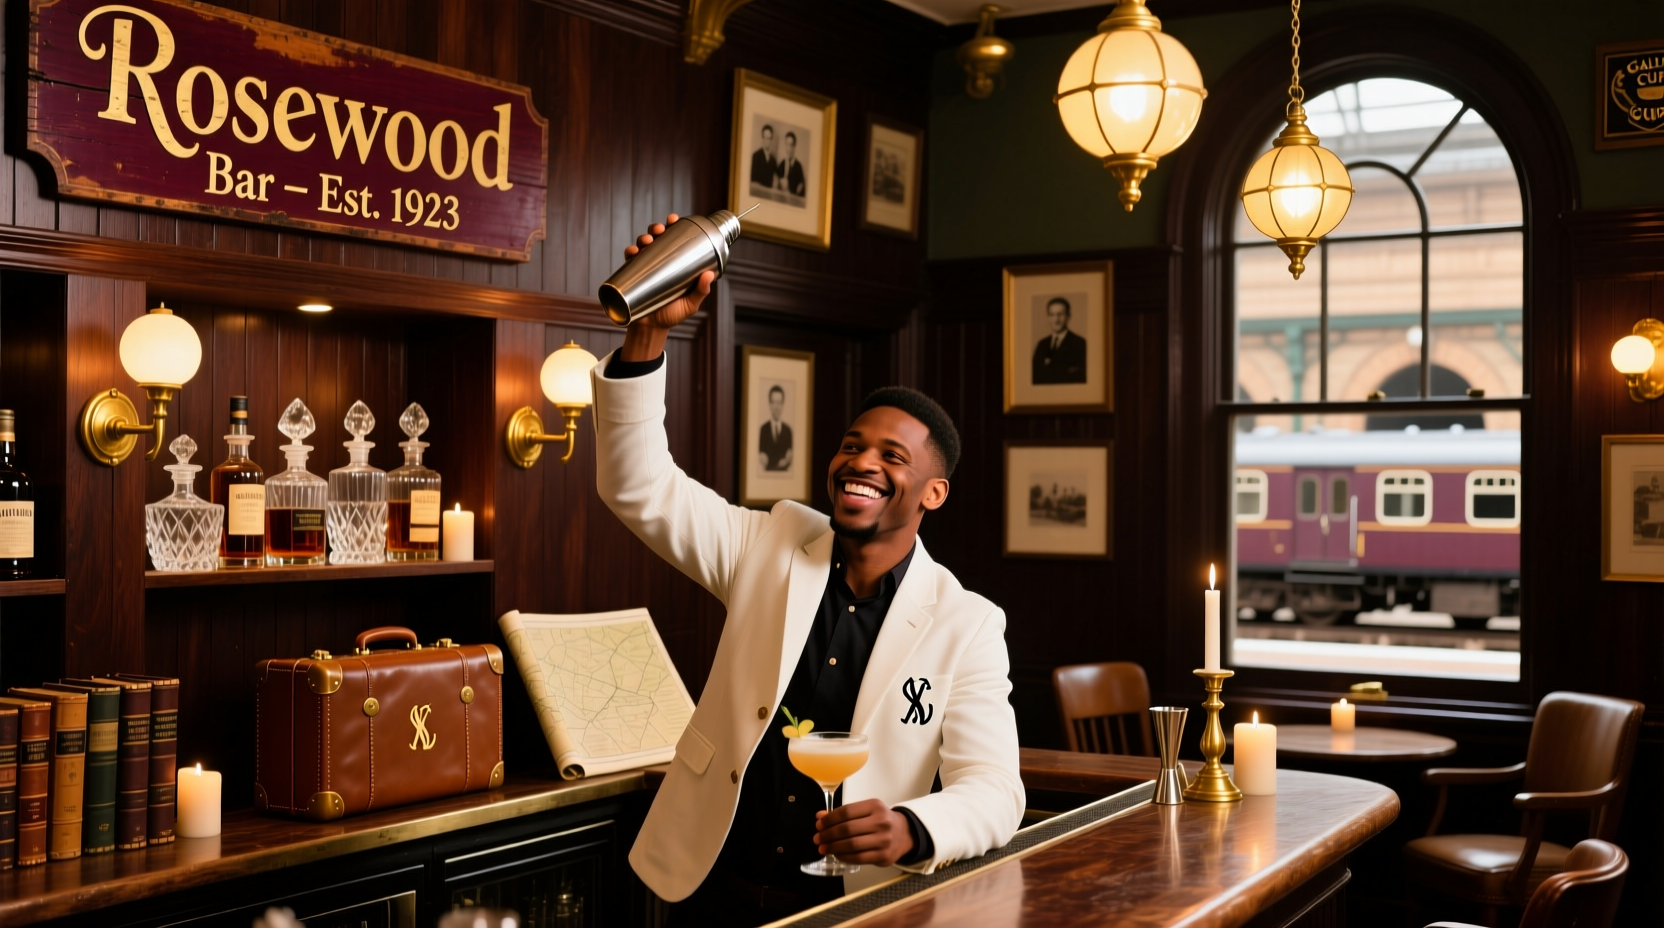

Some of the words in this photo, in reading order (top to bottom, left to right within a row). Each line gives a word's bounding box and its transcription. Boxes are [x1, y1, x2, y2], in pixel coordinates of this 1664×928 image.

[78, 4, 513, 191] Rosewood
[204, 151, 275, 202] Bar
[317, 173, 380, 219] Est.
[391, 188, 460, 231] 1923
